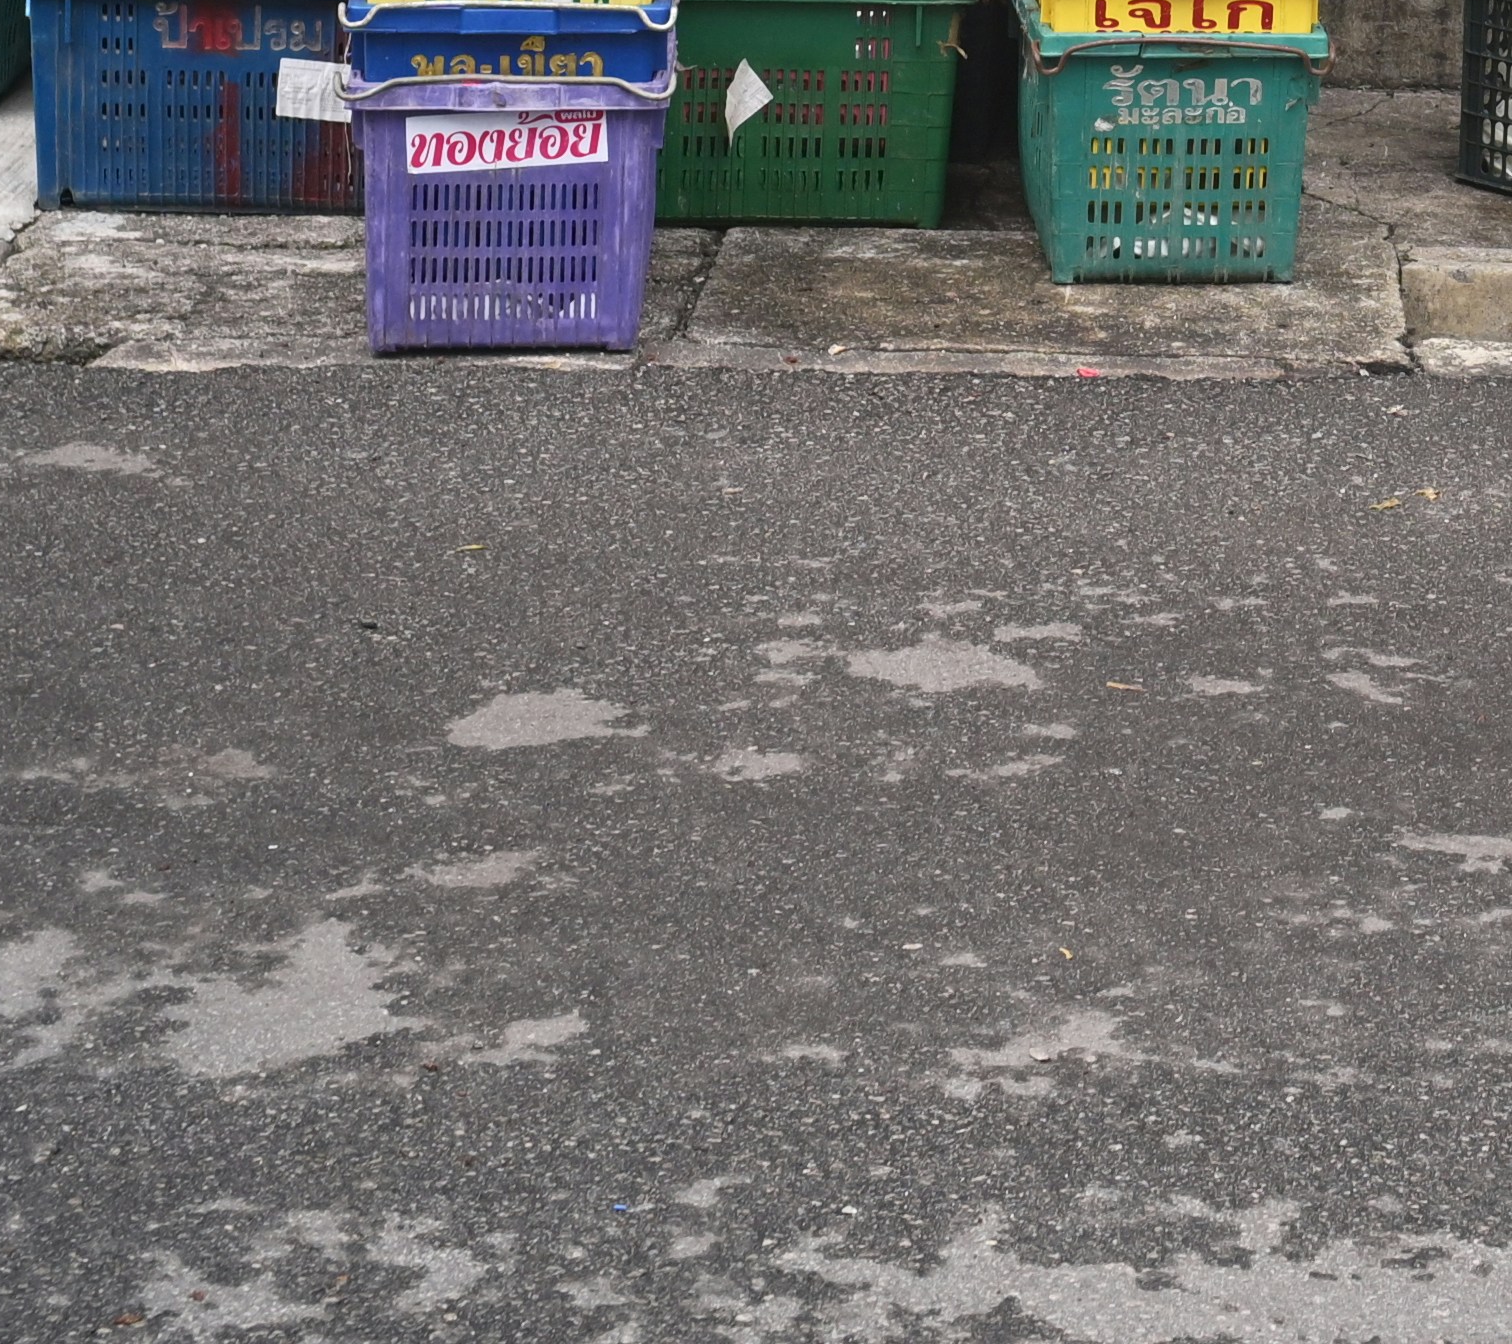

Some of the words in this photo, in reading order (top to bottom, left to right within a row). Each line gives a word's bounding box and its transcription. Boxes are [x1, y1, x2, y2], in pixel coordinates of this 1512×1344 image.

[152, 1, 322, 53] ป้าเปรม
[1102, 64, 1263, 106] รัตนา
[410, 112, 602, 169] ทองย้อย
